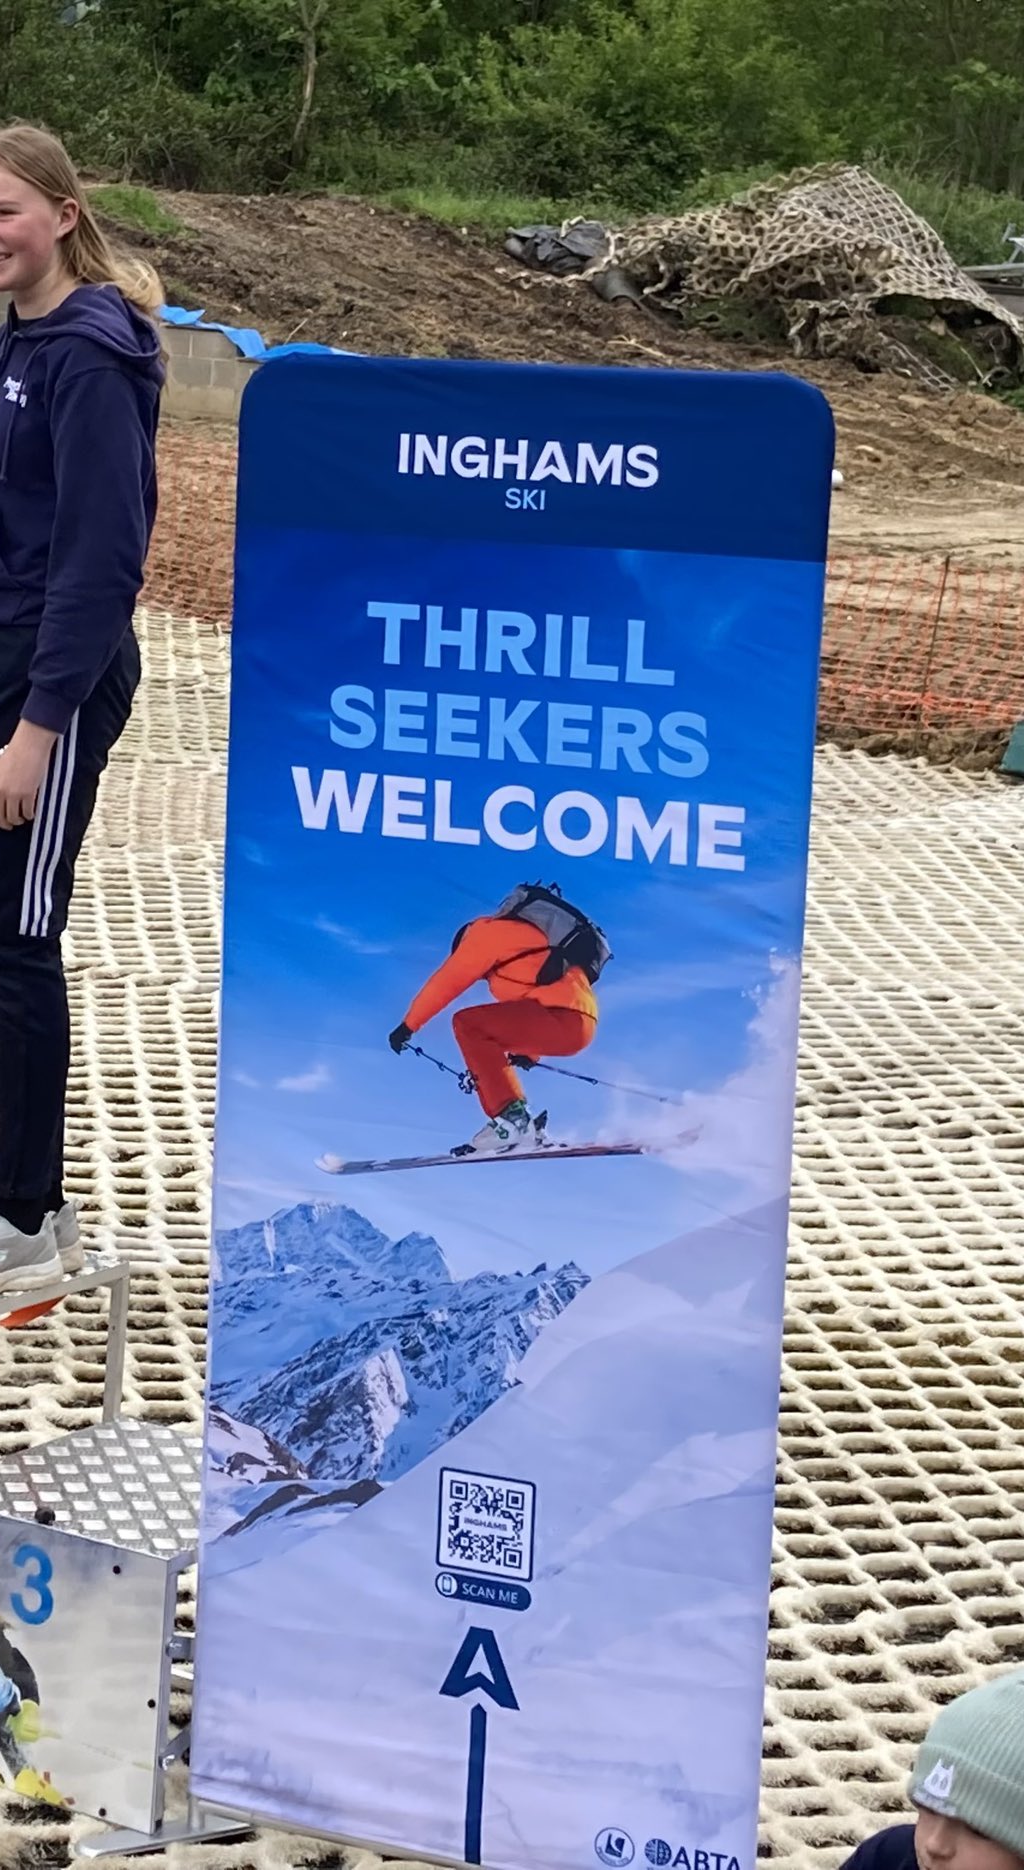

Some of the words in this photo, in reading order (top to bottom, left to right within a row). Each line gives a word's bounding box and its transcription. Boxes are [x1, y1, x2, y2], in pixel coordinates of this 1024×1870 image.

[397, 432, 660, 489] INGHAMS
[504, 488, 547, 511] SKI
[367, 601, 675, 686] THRILL
[329, 684, 710, 778] SEEKERS
[291, 765, 746, 871] WELCOME
[463, 1516, 508, 1532] INGHAMS
[10, 1543, 54, 1625] 3
[461, 1582, 495, 1600] SCAN
[498, 1589, 519, 1605] ME
[671, 1845, 741, 1870] ABTA
